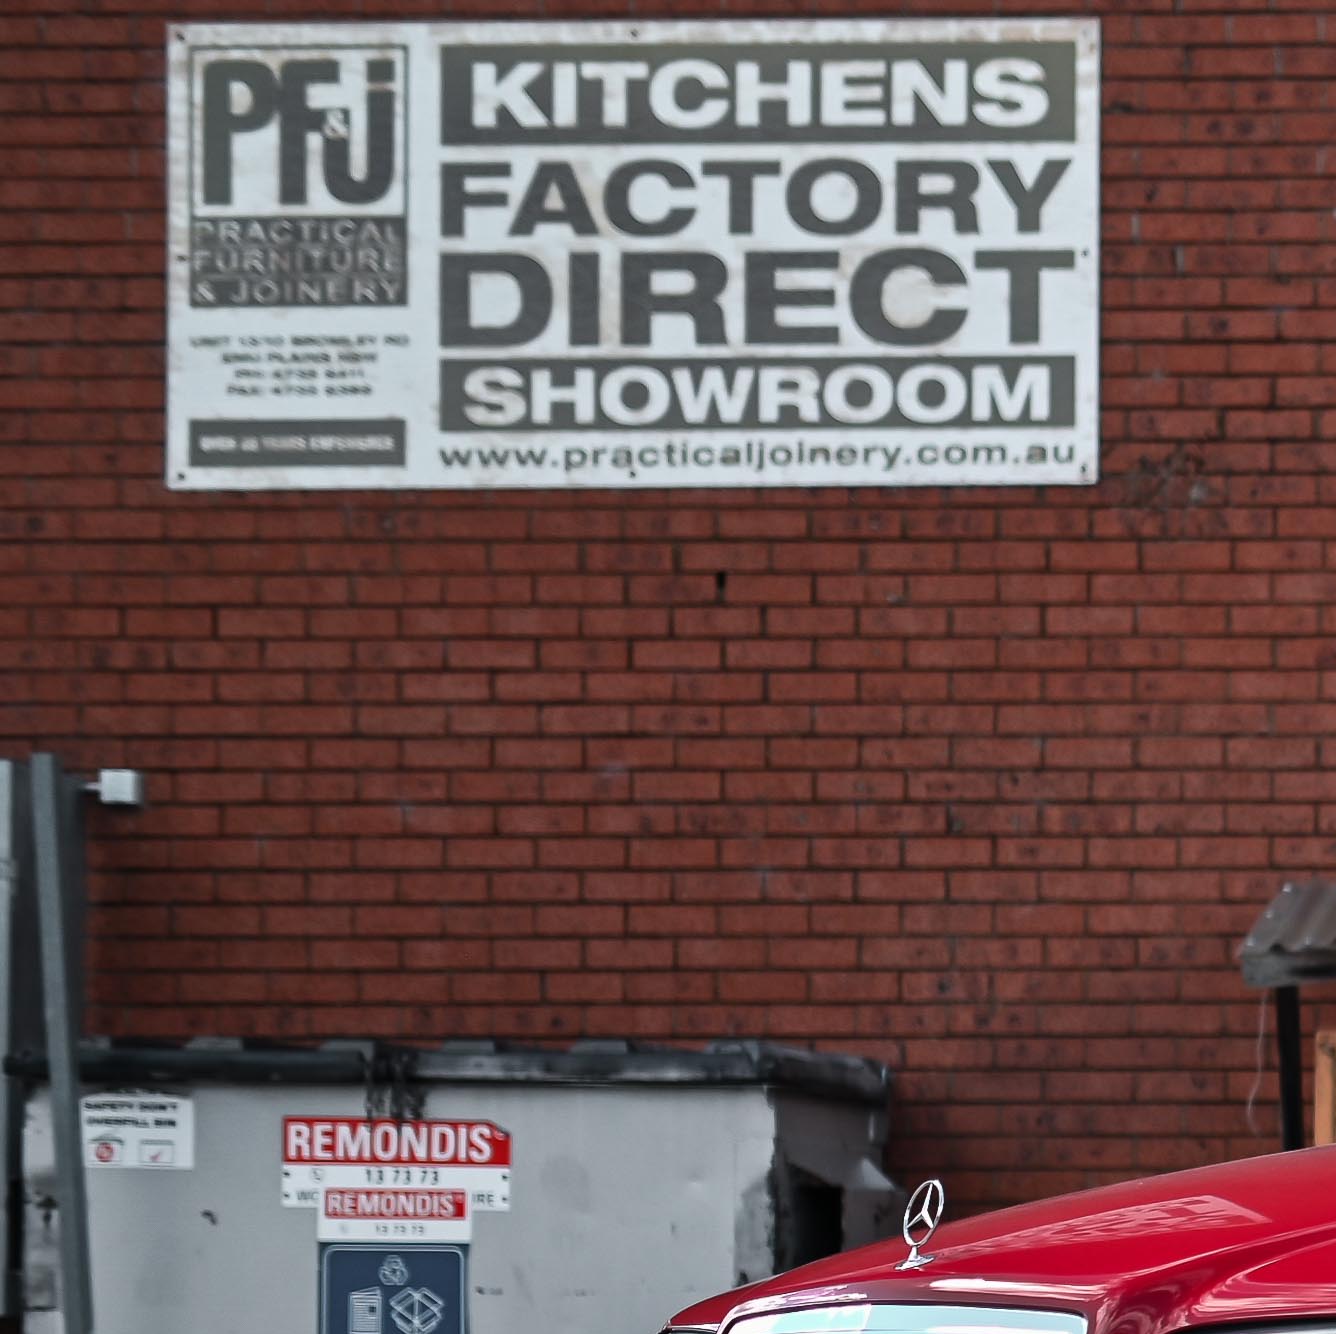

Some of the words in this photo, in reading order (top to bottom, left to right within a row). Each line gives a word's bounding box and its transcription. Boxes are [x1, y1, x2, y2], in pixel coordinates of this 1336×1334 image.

[471, 58, 1050, 128] KITCHENS
[440, 157, 1072, 237] FACTORY
[193, 218, 396, 245] PRACTICAL
[193, 248, 397, 274] FURNITURE
[230, 279, 398, 303] JOINERY
[439, 247, 1075, 347] DIRECT
[463, 364, 1050, 425] SHOWROOM
[438, 440, 1075, 473] www.practicaljoinery.com.au
[287, 1122, 493, 1163] REMONDIS
[365, 1168, 384, 1184] 13
[393, 1169, 411, 1185] 73
[421, 1169, 439, 1185] 73
[327, 1193, 454, 1217] REMONDIS
